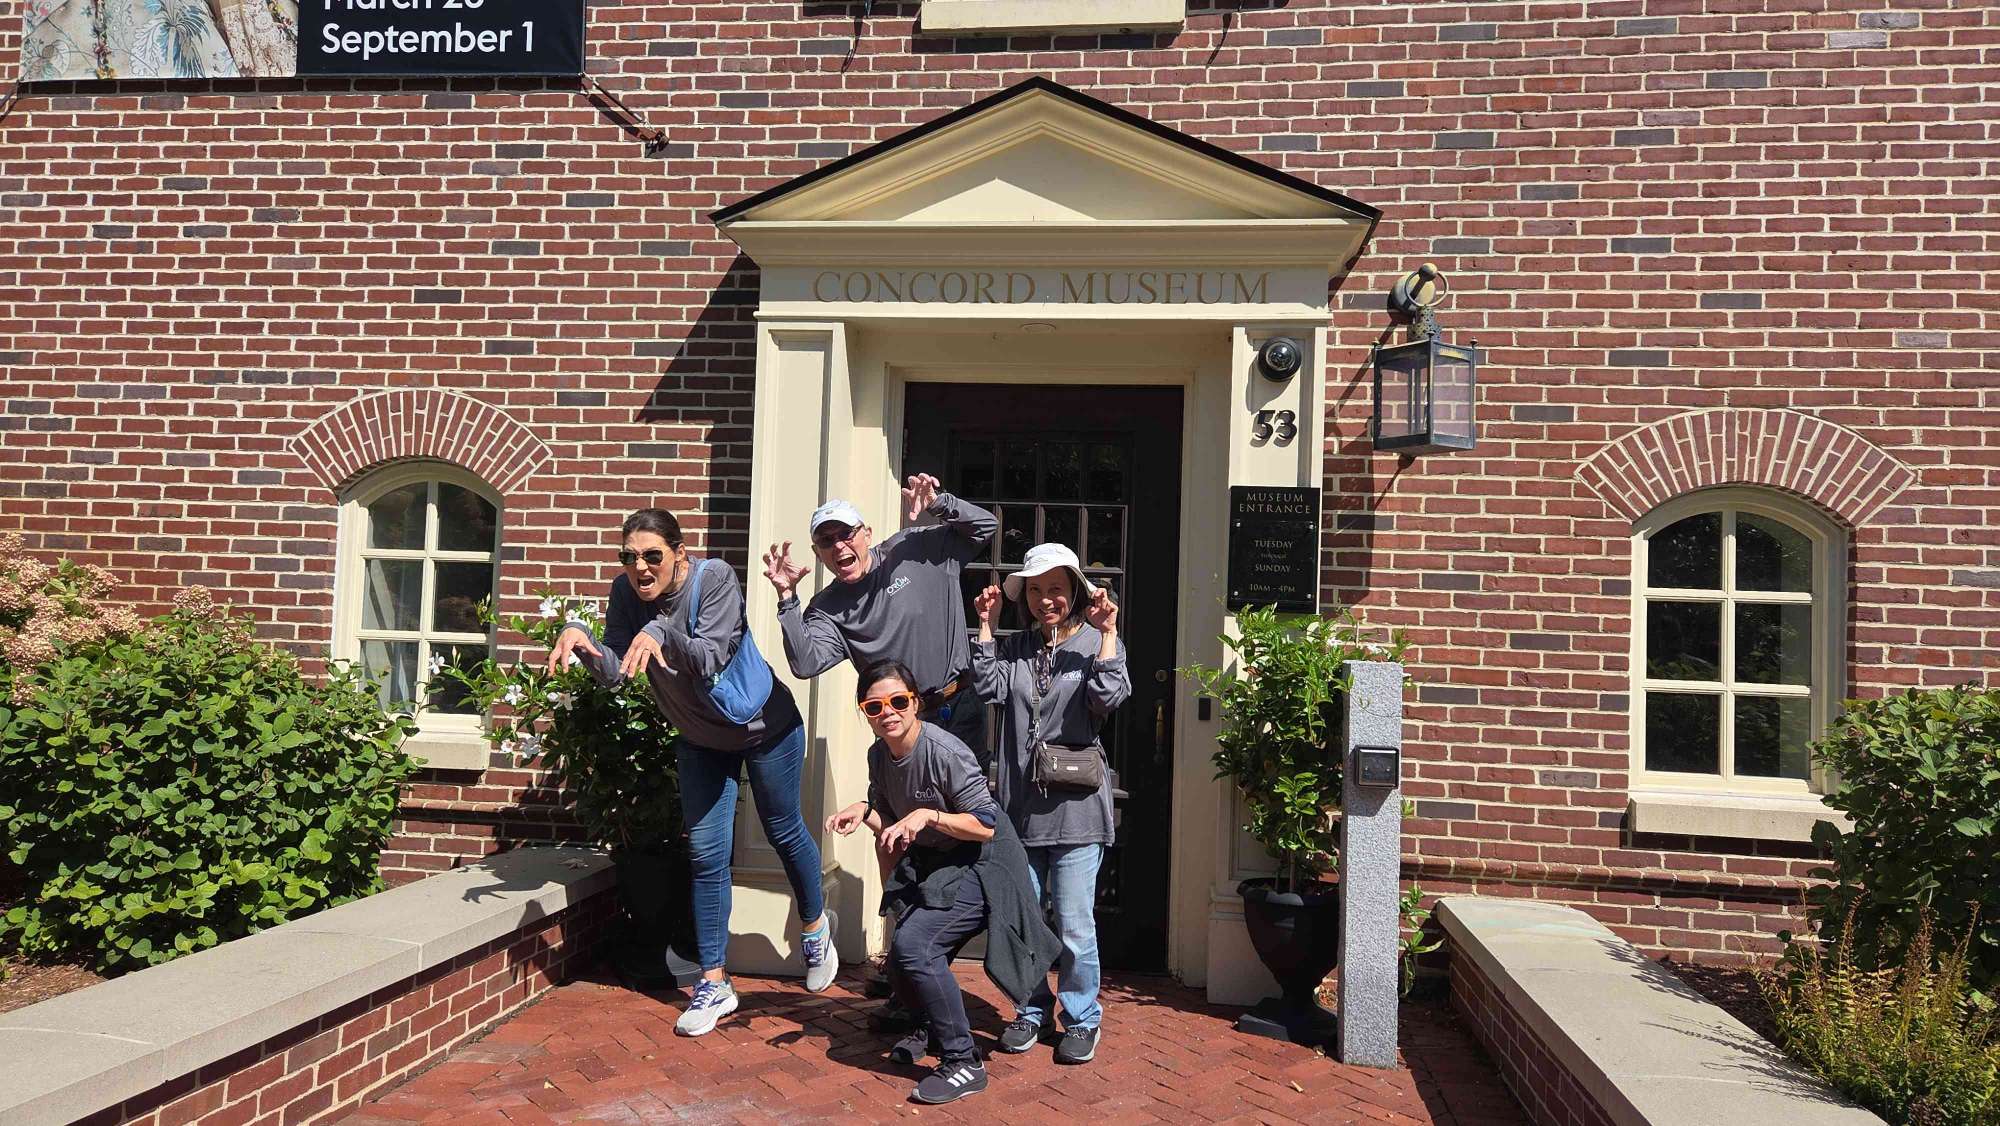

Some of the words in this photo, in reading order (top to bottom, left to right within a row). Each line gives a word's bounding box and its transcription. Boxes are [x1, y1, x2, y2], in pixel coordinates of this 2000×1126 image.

[321, 22, 513, 60] September
[521, 21, 534, 52] 1
[814, 271, 1036, 303] CONCORD
[1060, 271, 1270, 304] MUSEUM
[1254, 410, 1297, 439] 53
[1247, 492, 1304, 503] MUSEUM
[1239, 503, 1313, 514] ENTRANCE
[1254, 540, 1294, 550] TUESDAY
[1255, 564, 1292, 573] SUNDAY
[1249, 583, 1272, 593] 10AM
